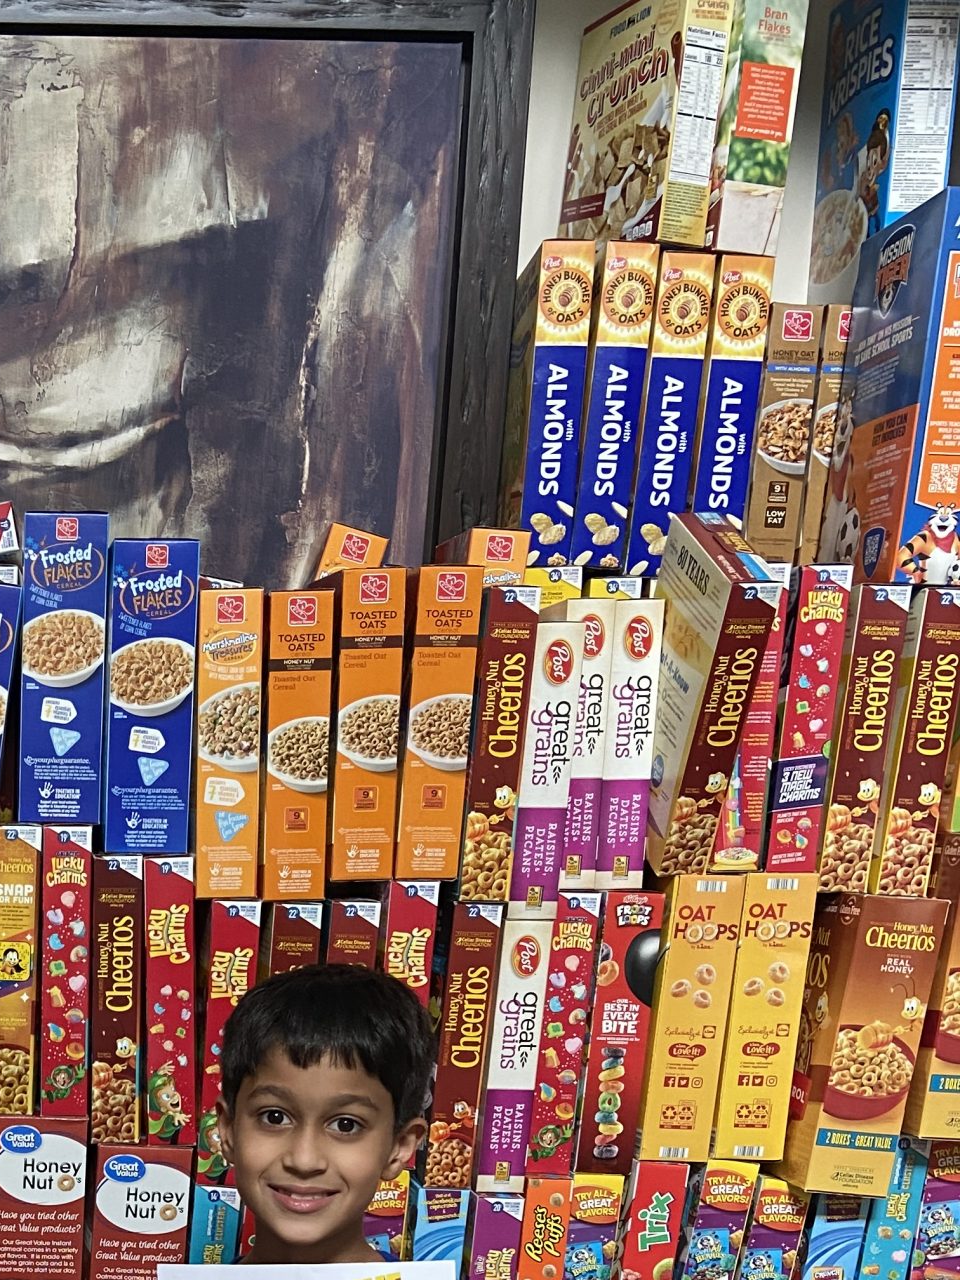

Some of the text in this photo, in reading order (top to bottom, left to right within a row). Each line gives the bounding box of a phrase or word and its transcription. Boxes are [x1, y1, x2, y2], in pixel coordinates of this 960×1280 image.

[764, 7, 788, 20] Bran
[758, 19, 791, 34] Flakes
[843, 8, 881, 65] RICE
[580, 25, 656, 101] cinni-mini
[587, 47, 670, 127] crunch
[828, 40, 894, 128] KRISPIES
[545, 258, 562, 268] Post
[543, 271, 590, 304] HONEY BUNCHES
[556, 309, 584, 323] OATS
[538, 364, 568, 496] ALMONDS
[566, 419, 574, 441] with
[649, 376, 683, 507] ALMONDS
[708, 378, 743, 509] ALMONDS
[766, 510, 785, 518] LOW
[767, 518, 783, 526] FAT
[808, 591, 842, 607] Lucky
[800, 607, 844, 622] Charms
[277, 634, 326, 644] TOASTED
[288, 643, 315, 652] OATS
[551, 646, 568, 684] Post
[855, 649, 894, 752] Cheerios
[546, 701, 571, 764] great
[531, 709, 554, 786] grains
[782, 772, 789, 782] 3
[791, 771, 811, 781] NEW
[780, 780, 812, 792] MAGIC
[779, 789, 820, 803] CHARMS
[749, 904, 784, 919] OAT
[893, 922, 934, 934] Honey Nut
[865, 924, 935, 951] Cheerios
[880, 965, 914, 974] HONEY
[886, 958, 910, 967] REAL
[604, 1003, 639, 1013] BEST IN
[603, 1011, 638, 1022] EVERY
[603, 1019, 637, 1034] BITE
[5, 1132, 34, 1142] Great
[12, 1139, 34, 1147] Value
[825, 1132, 892, 1148] 2 BOXES GREAT VALUE
[23, 1158, 82, 1176] Honey
[23, 1174, 53, 1189] Nut
[575, 1190, 618, 1201] TRY ALL 3
[580, 1199, 614, 1208] GREAT
[20, 1213, 35, 1221] you
[37, 1211, 55, 1220] tried
[57, 1212, 79, 1220] other
[575, 1207, 617, 1218] FLAVORS!
[638, 1191, 675, 1252] Trix
[525, 1206, 548, 1262] Reese's
[544, 1214, 564, 1256] Puffs
